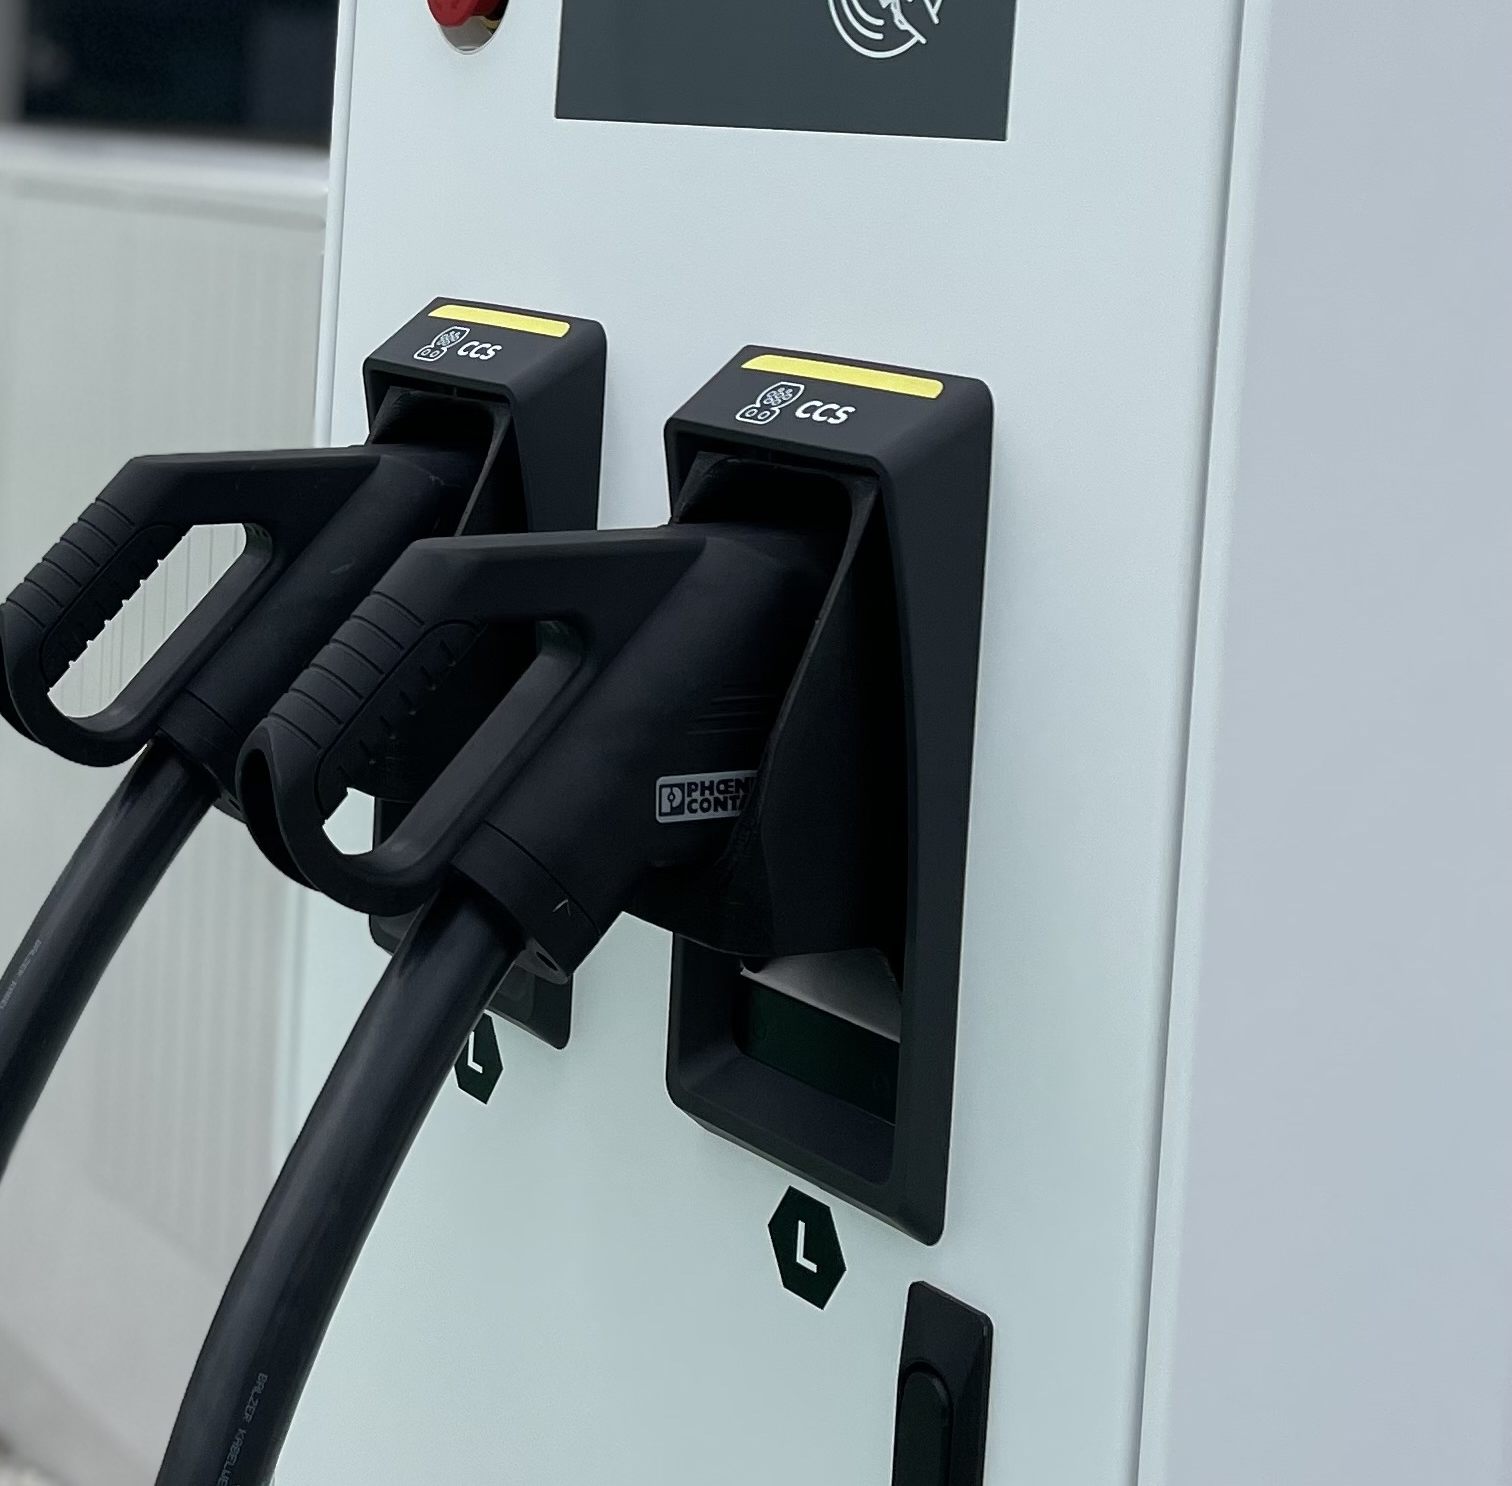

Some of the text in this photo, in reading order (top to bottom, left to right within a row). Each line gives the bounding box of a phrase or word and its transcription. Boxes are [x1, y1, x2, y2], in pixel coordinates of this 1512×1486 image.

[457, 340, 502, 361] CCS
[794, 400, 856, 425] CCS
[796, 1220, 817, 1273] L
